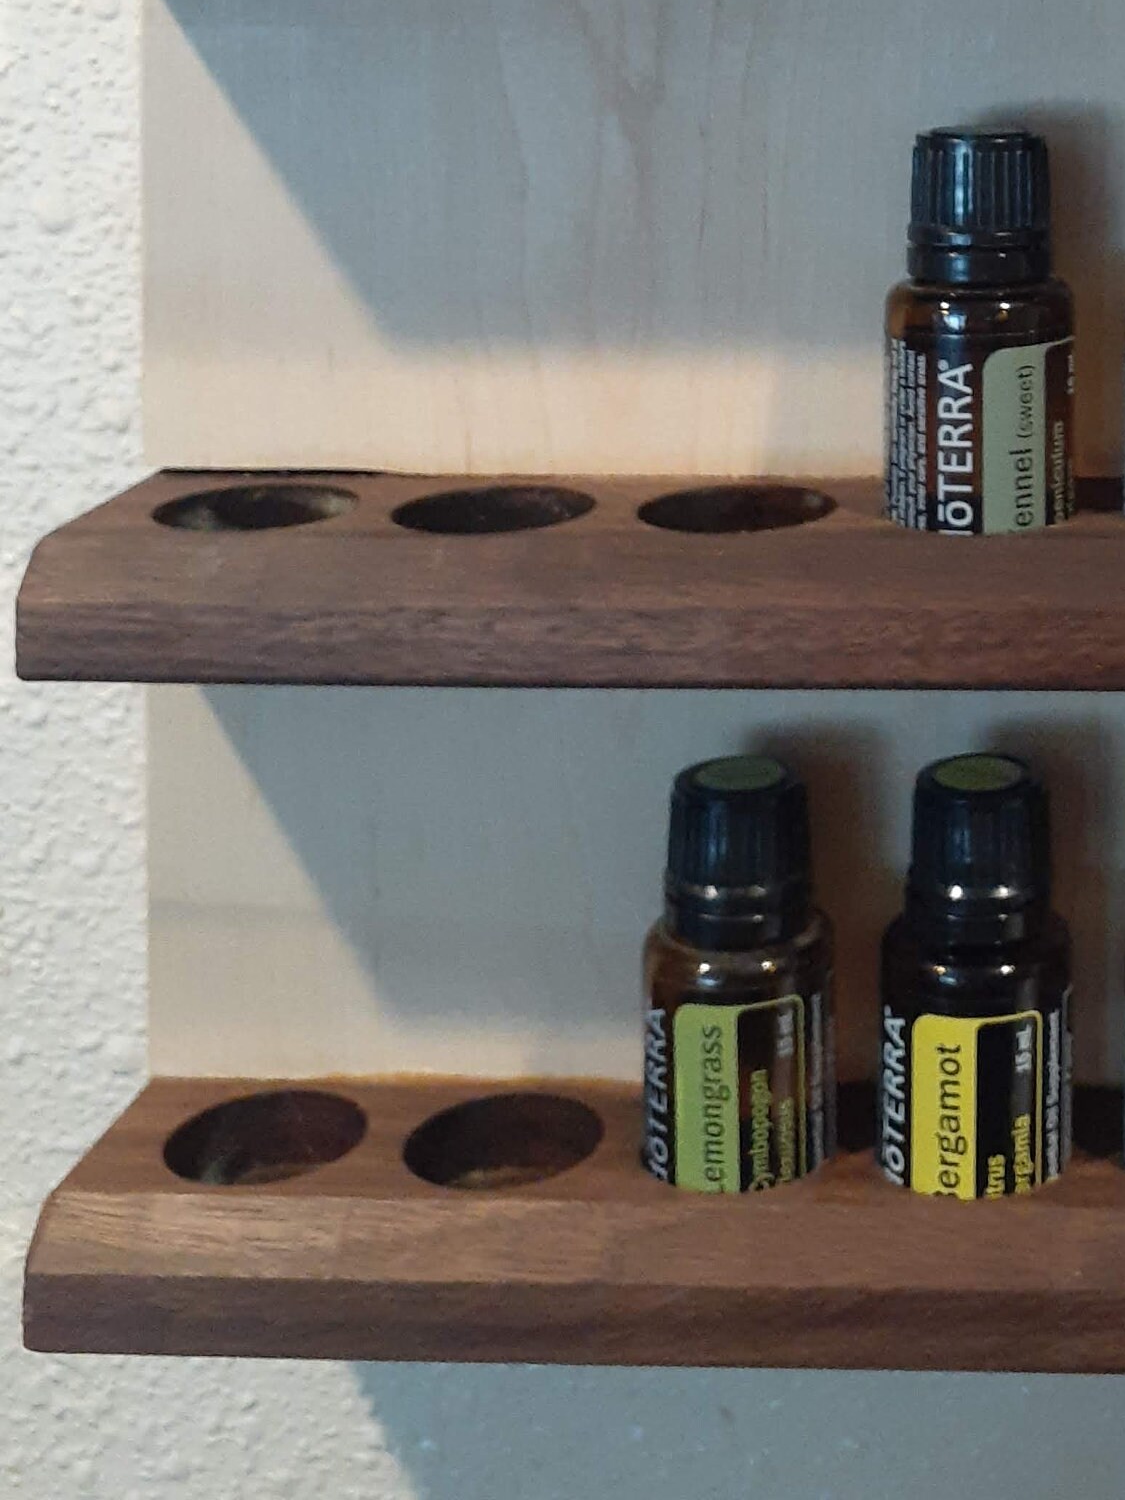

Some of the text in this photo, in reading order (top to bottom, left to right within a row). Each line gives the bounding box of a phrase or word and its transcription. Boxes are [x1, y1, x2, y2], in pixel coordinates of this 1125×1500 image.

[1009, 365, 1035, 527] ennel (sweet)
[702, 1024, 731, 1182] emongrass
